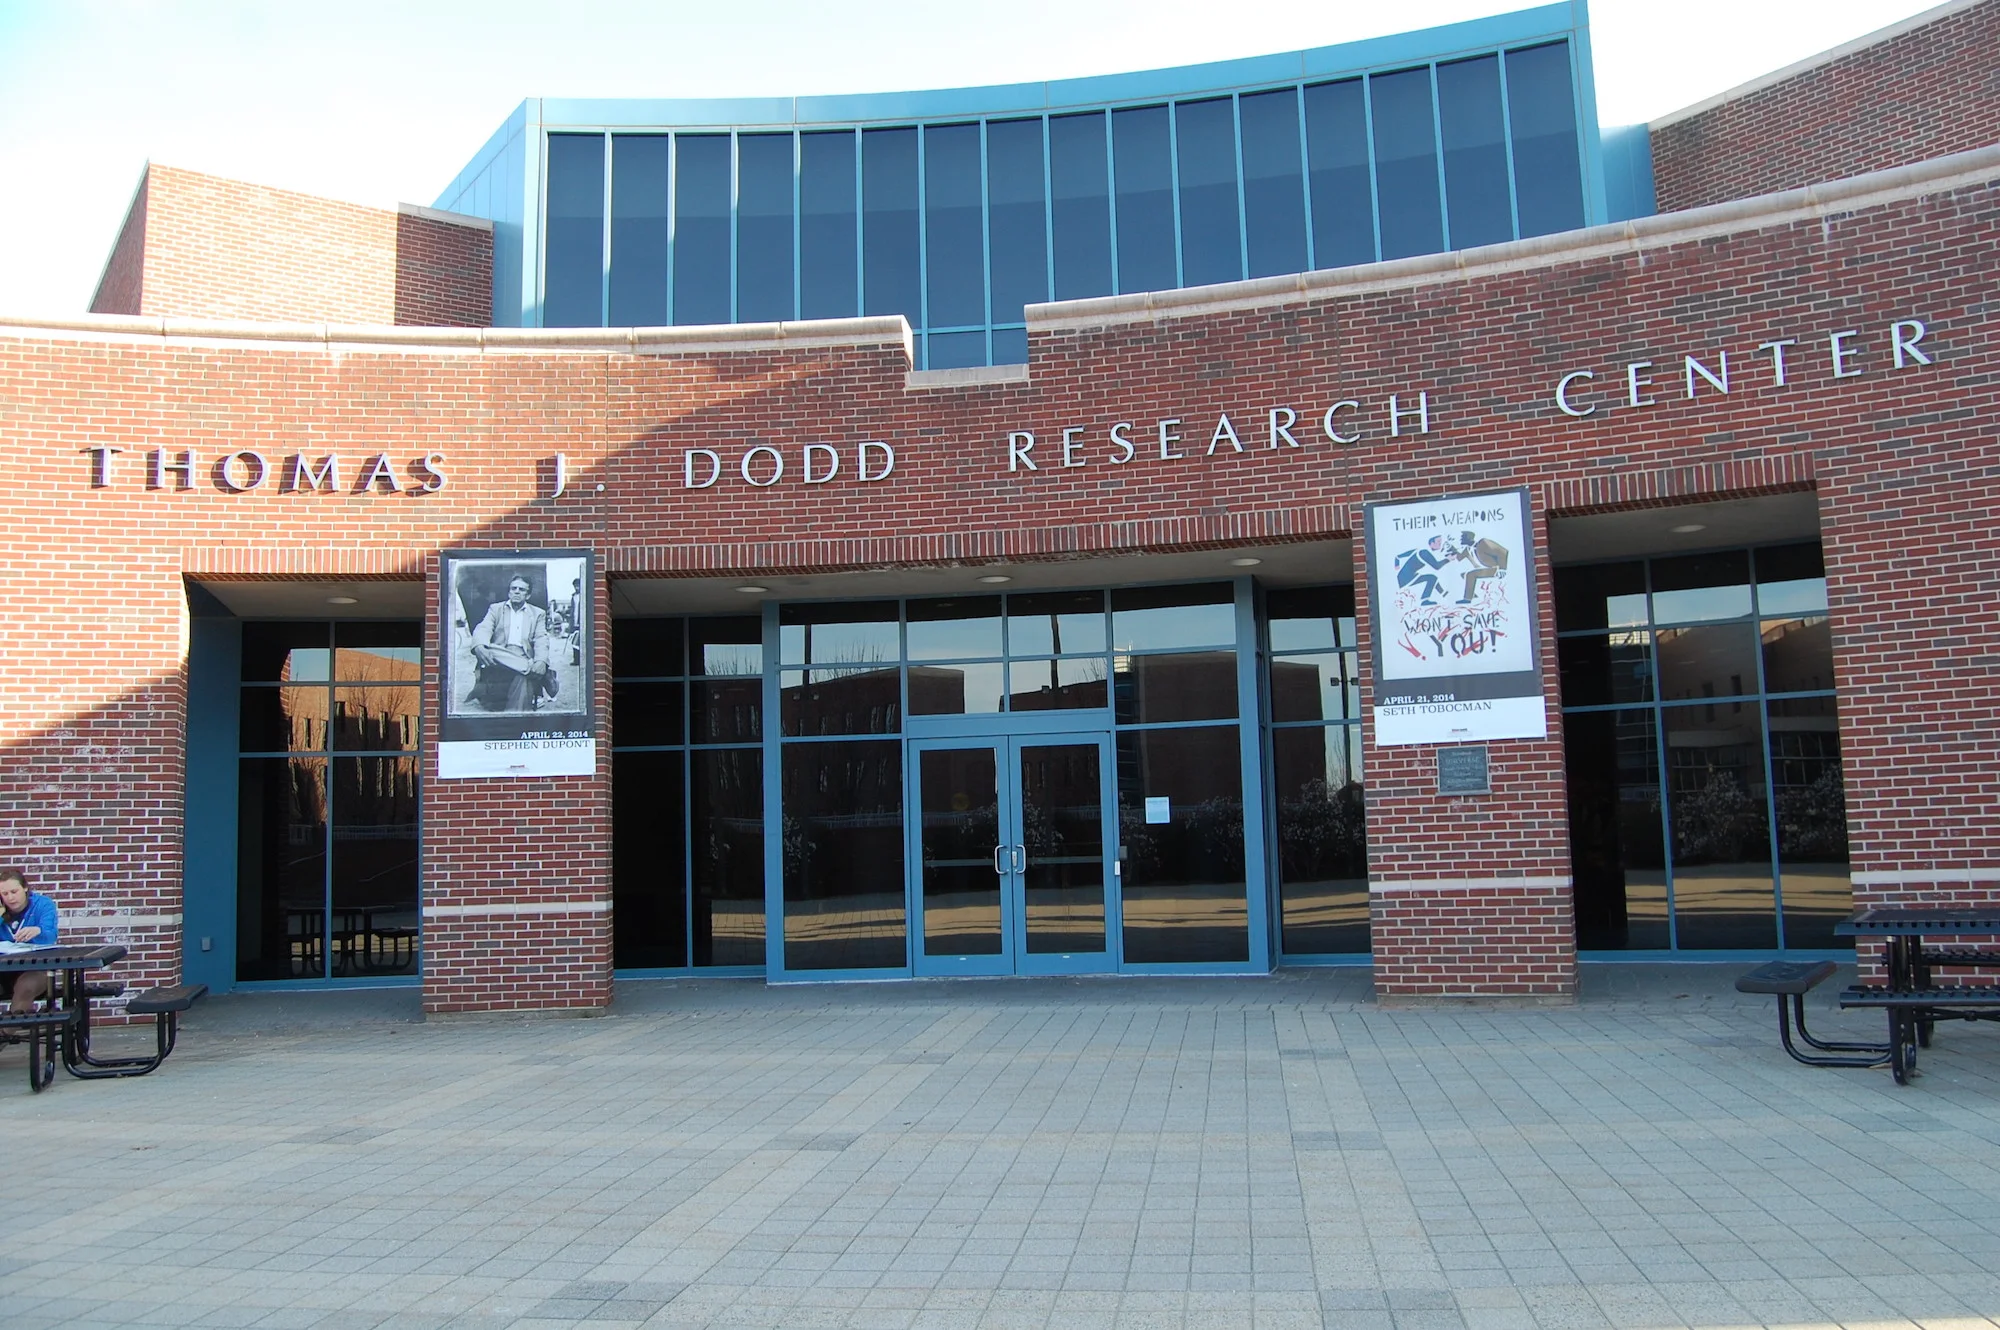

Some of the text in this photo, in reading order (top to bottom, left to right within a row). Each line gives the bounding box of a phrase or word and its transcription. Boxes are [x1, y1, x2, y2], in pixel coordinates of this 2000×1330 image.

[86, 318, 1933, 499] THOMAS J. DODD RESEARCH CENTER
[1392, 507, 1505, 531] THEIR WEAPONS
[1463, 612, 1500, 630] SAVE
[1429, 629, 1497, 657] YOU!
[1383, 693, 1455, 706] APRIL 21, 2014
[1382, 701, 1492, 717] SETH TOBOCMAN
[520, 730, 589, 740] APRIL 22, 2014
[484, 739, 591, 751] STEPHEN DUPONT
